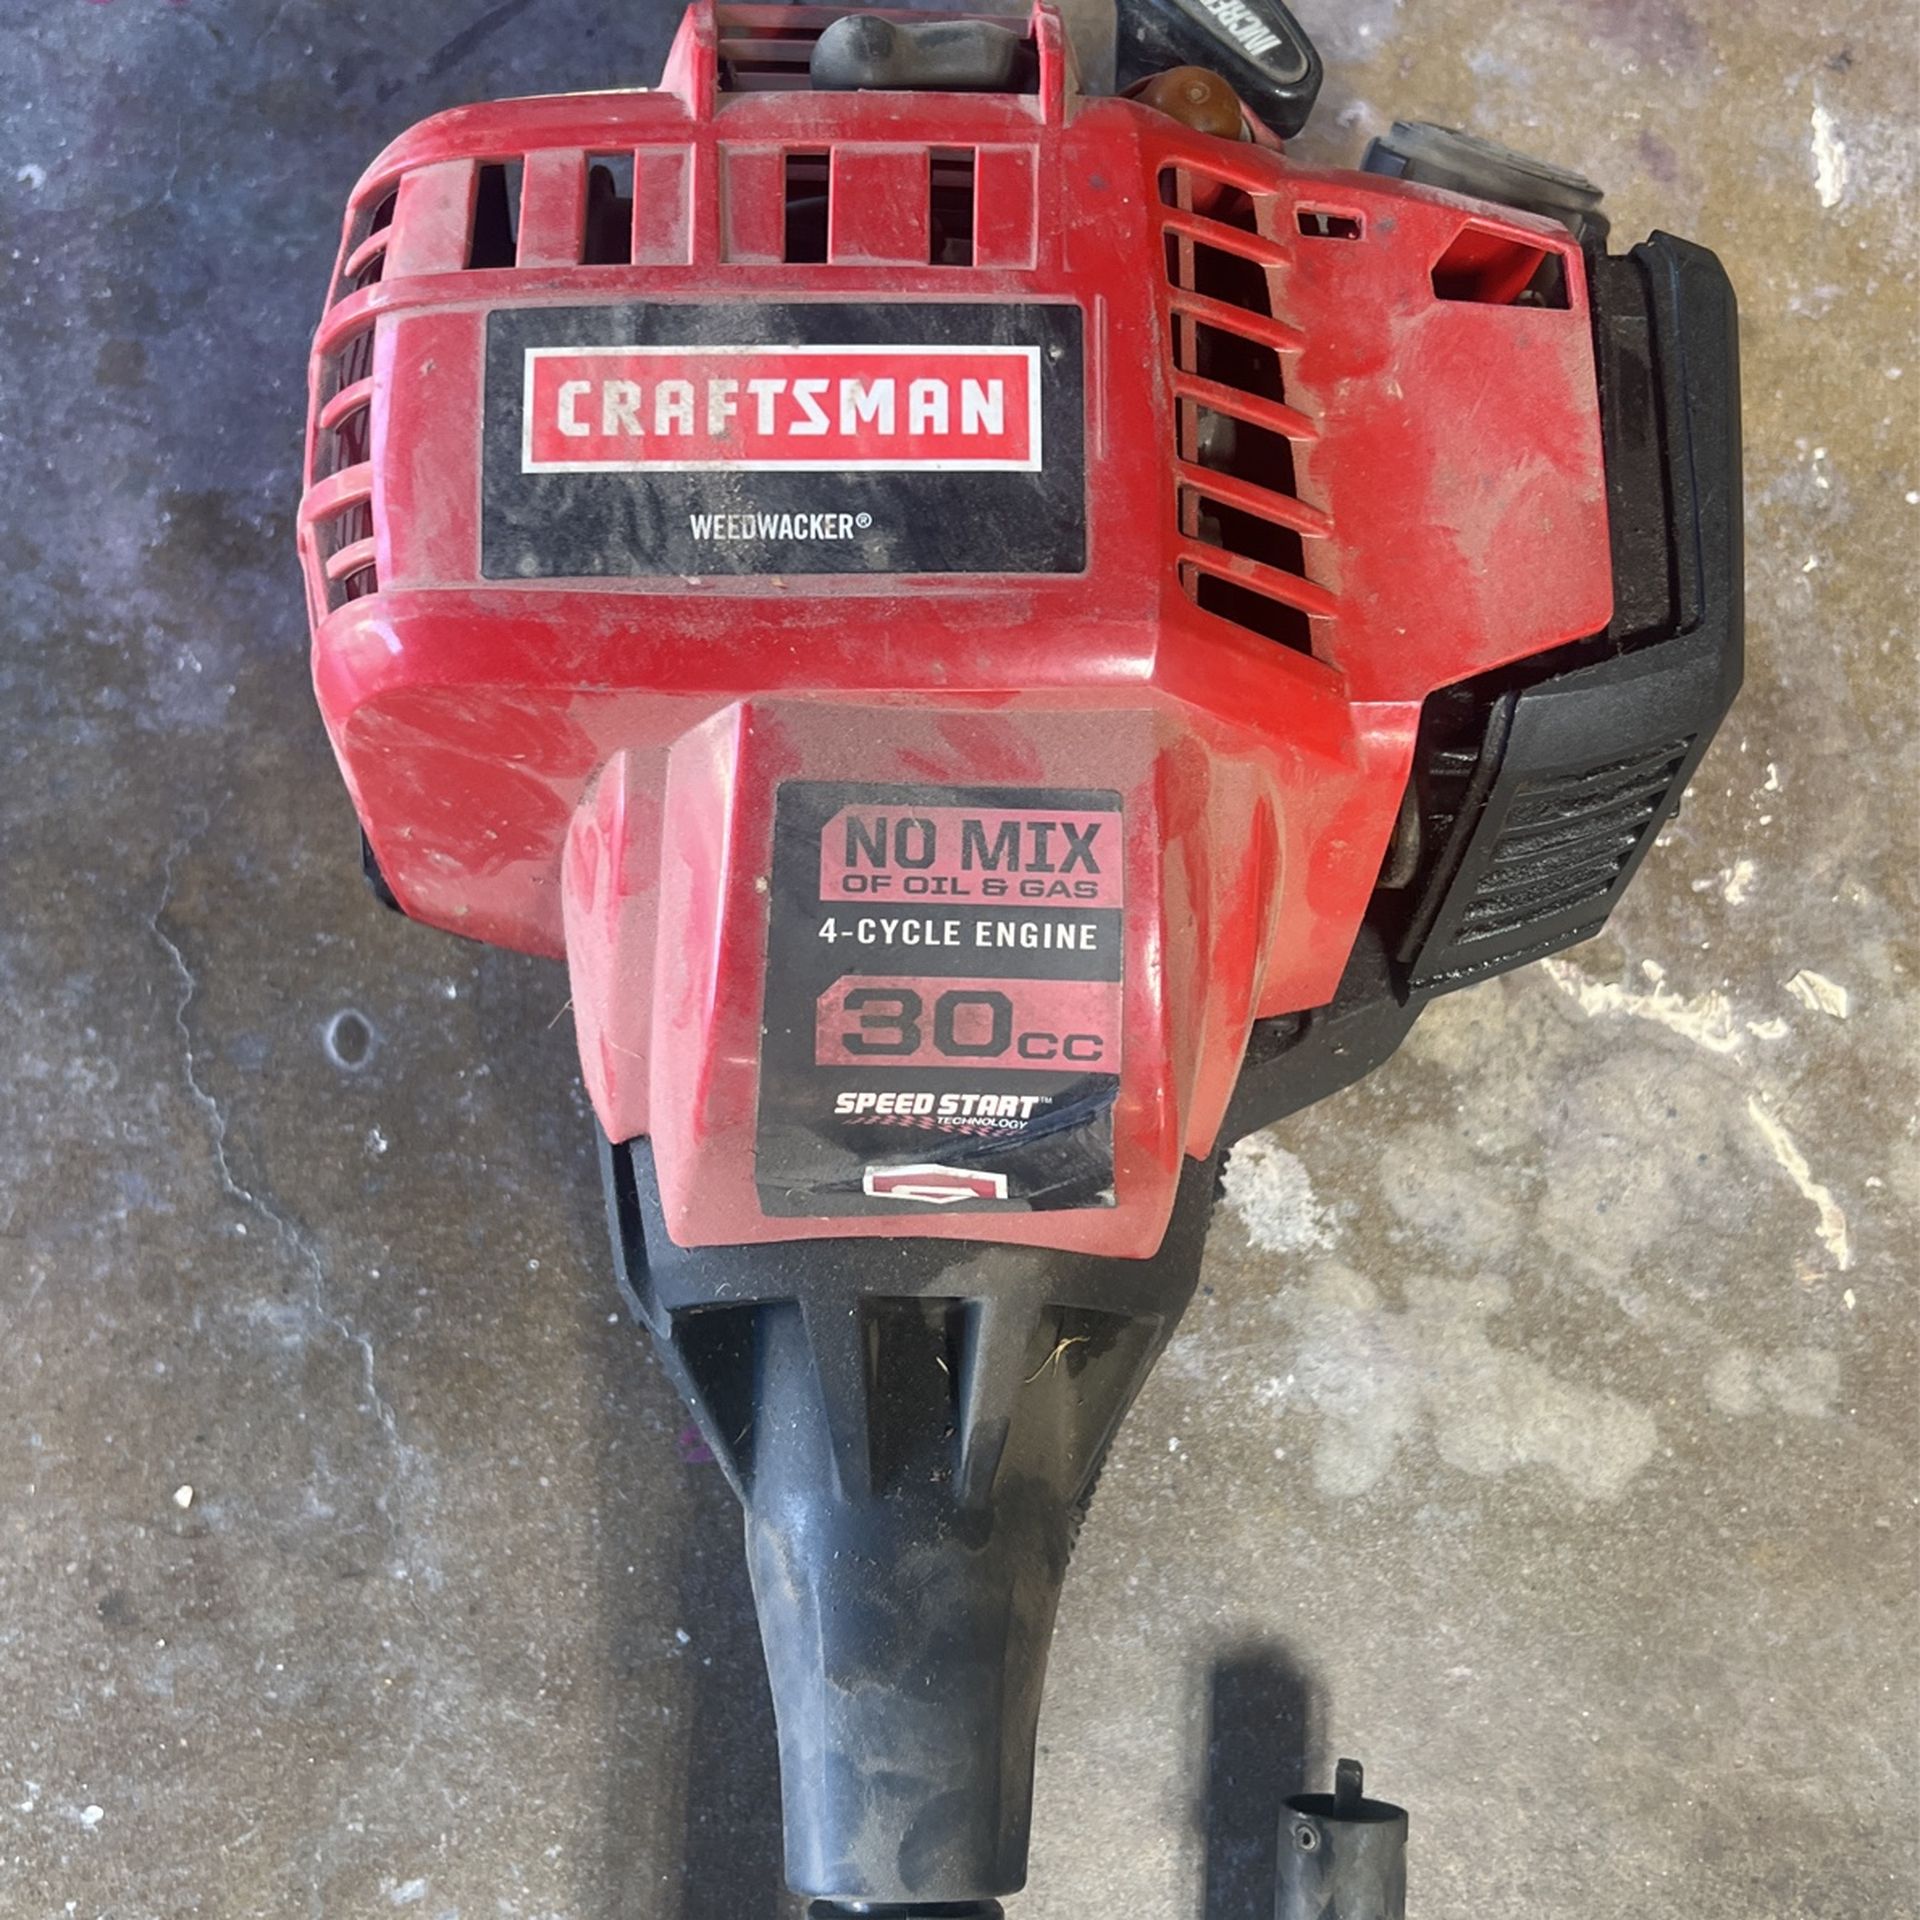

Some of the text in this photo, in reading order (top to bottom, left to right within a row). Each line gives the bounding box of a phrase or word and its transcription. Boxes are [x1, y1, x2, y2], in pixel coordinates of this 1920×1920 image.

[557, 377, 1004, 437] CRAFTSMAN
[845, 815, 1102, 875] NO MIX
[841, 874, 1099, 899] OF OIL & GAS
[818, 917, 1098, 951] 4-CYCLE ENGINE
[834, 1092, 935, 1115] SPEED
[936, 1116, 1029, 1131] TECHNOLOGY
